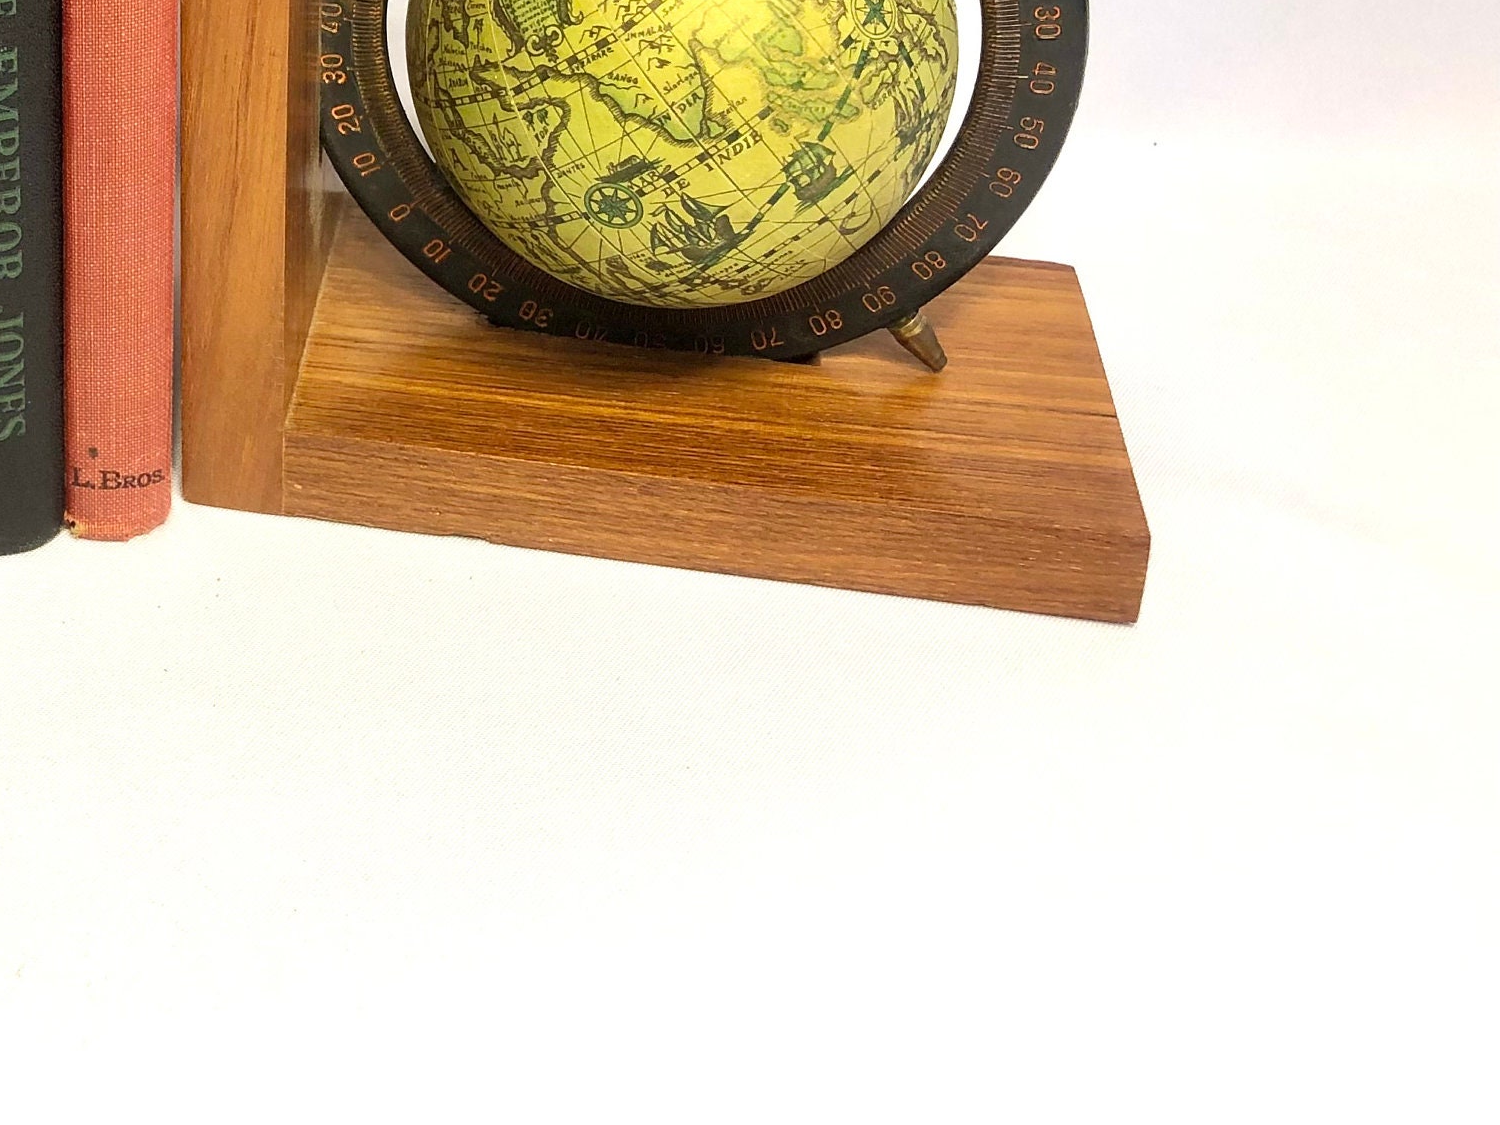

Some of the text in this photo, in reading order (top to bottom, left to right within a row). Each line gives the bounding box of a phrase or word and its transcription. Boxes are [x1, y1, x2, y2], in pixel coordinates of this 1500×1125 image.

[1033, 5, 1061, 41] 30
[320, 53, 346, 85] 30
[1029, 61, 1057, 96] 40
[331, 103, 361, 136] 20
[1013, 116, 1045, 151] 50
[352, 150, 381, 177] 10
[989, 166, 1021, 199] 60
[389, 202, 411, 223] 0
[953, 213, 989, 243] 70
[422, 237, 452, 265] 10
[911, 250, 946, 281] 80
[468, 273, 505, 303] 20
[861, 285, 897, 314] 90
[518, 300, 554, 328] 30
[808, 309, 843, 336] 80
[750, 327, 784, 351] 70
